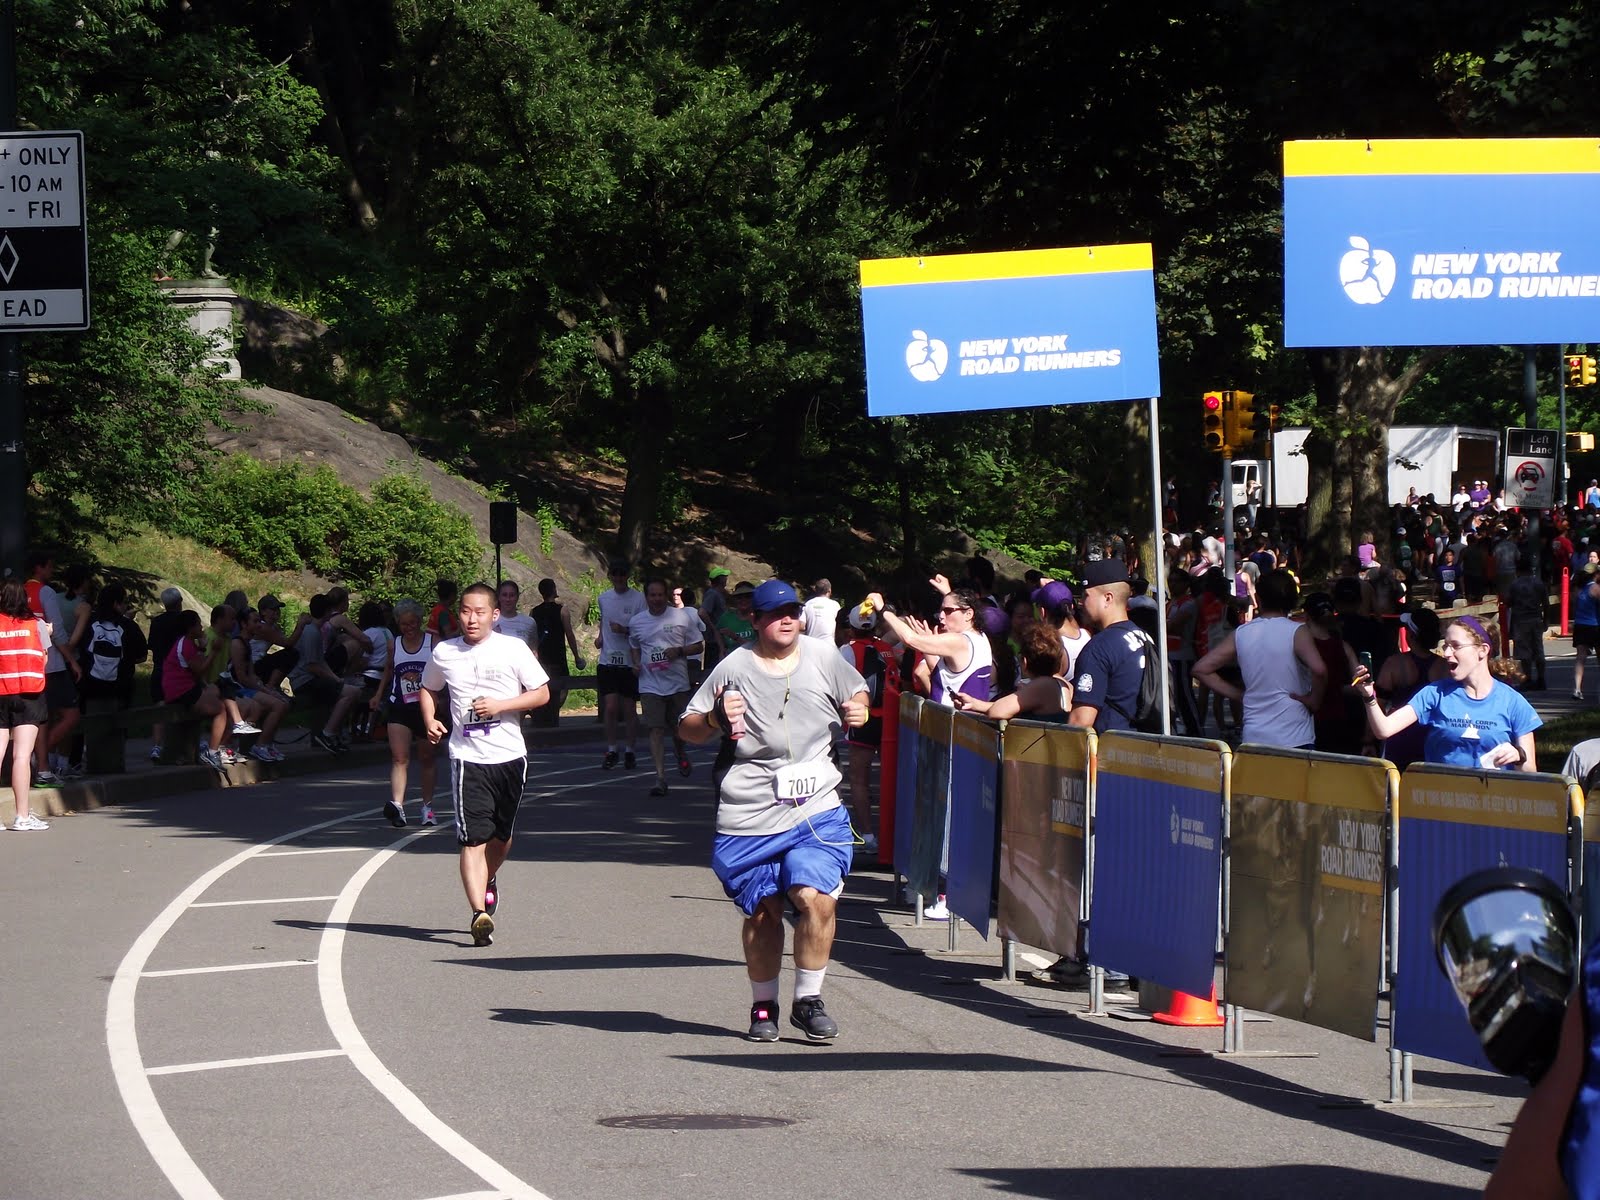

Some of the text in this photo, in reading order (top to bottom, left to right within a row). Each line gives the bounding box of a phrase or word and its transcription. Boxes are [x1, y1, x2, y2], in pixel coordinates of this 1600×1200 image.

[19, 147, 71, 165] ONLY
[37, 178, 62, 192] AM
[29, 201, 60, 219] FRI
[1412, 252, 1562, 275] NEW YORK
[1412, 275, 1600, 300] ROAD RUNNE
[4, 299, 47, 317] EAD
[960, 335, 1068, 357] NEW YORK
[960, 349, 1121, 376] ROAD RUNNERS
[1530, 434, 1549, 444] Left
[1529, 445, 1553, 454] Lane
[651, 652, 666, 662] 6312
[406, 681, 422, 692] 643
[788, 776, 817, 796] 7017
[1339, 820, 1382, 852] NEW YORK
[1321, 845, 1382, 882] ROAD RUNNERS
